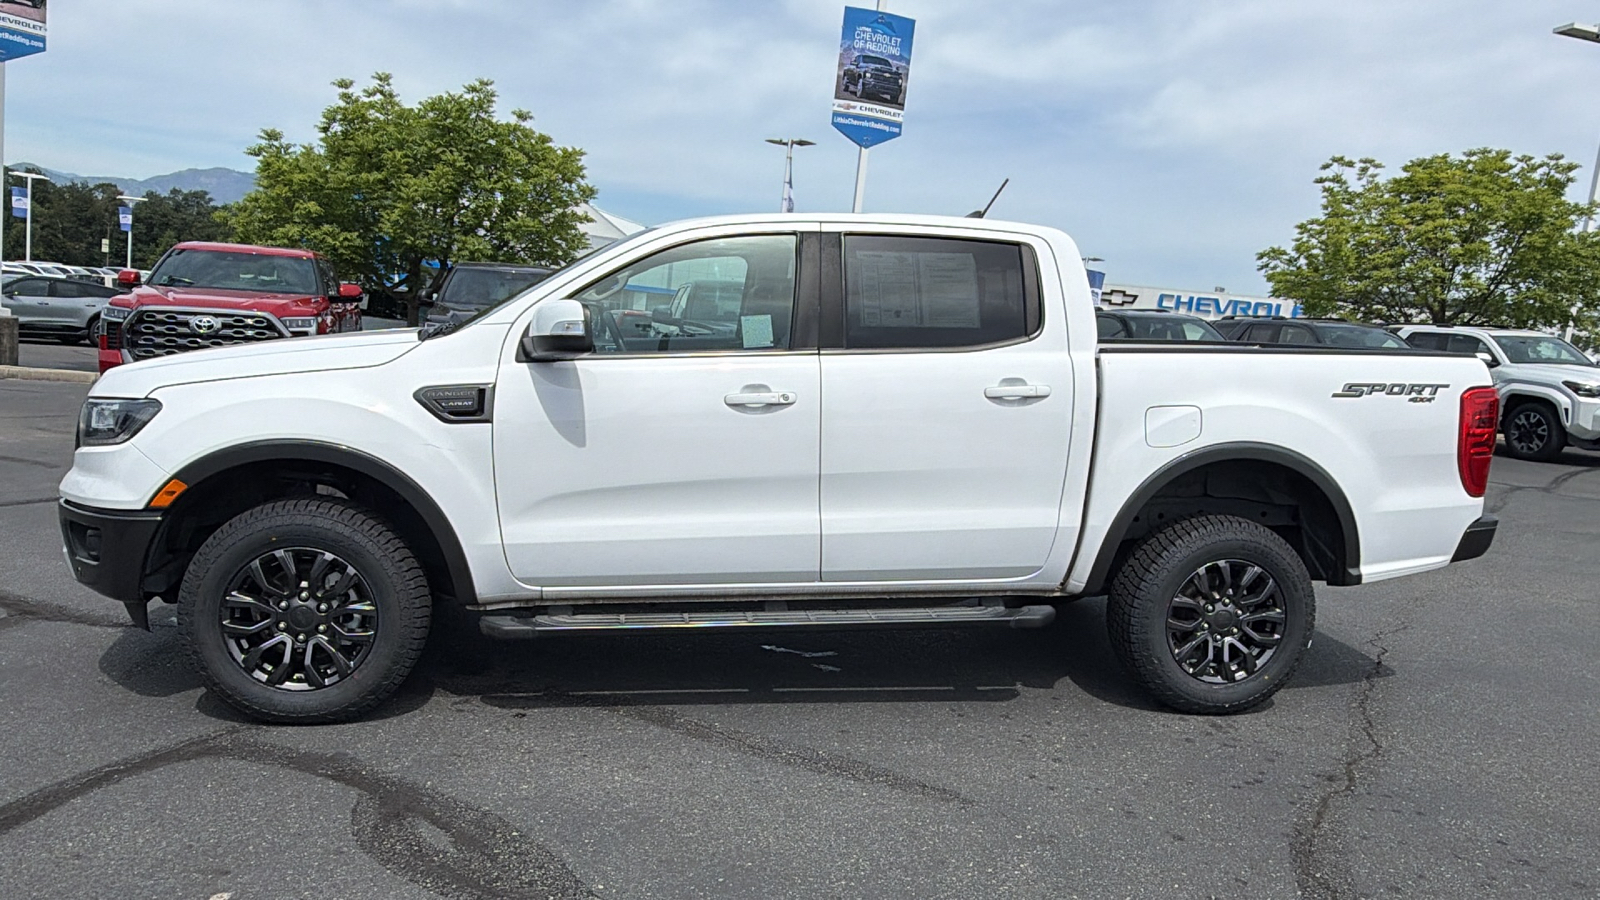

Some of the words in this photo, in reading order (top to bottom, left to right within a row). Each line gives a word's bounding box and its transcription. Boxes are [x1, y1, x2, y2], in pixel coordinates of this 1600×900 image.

[0, 16, 44, 31] EVROLET
[855, 31, 901, 46] CHEVROLET
[854, 40, 865, 48] OF
[866, 42, 900, 55] REDDING
[859, 105, 901, 117] CHEVROLET
[1331, 383, 1450, 398] SPORT
